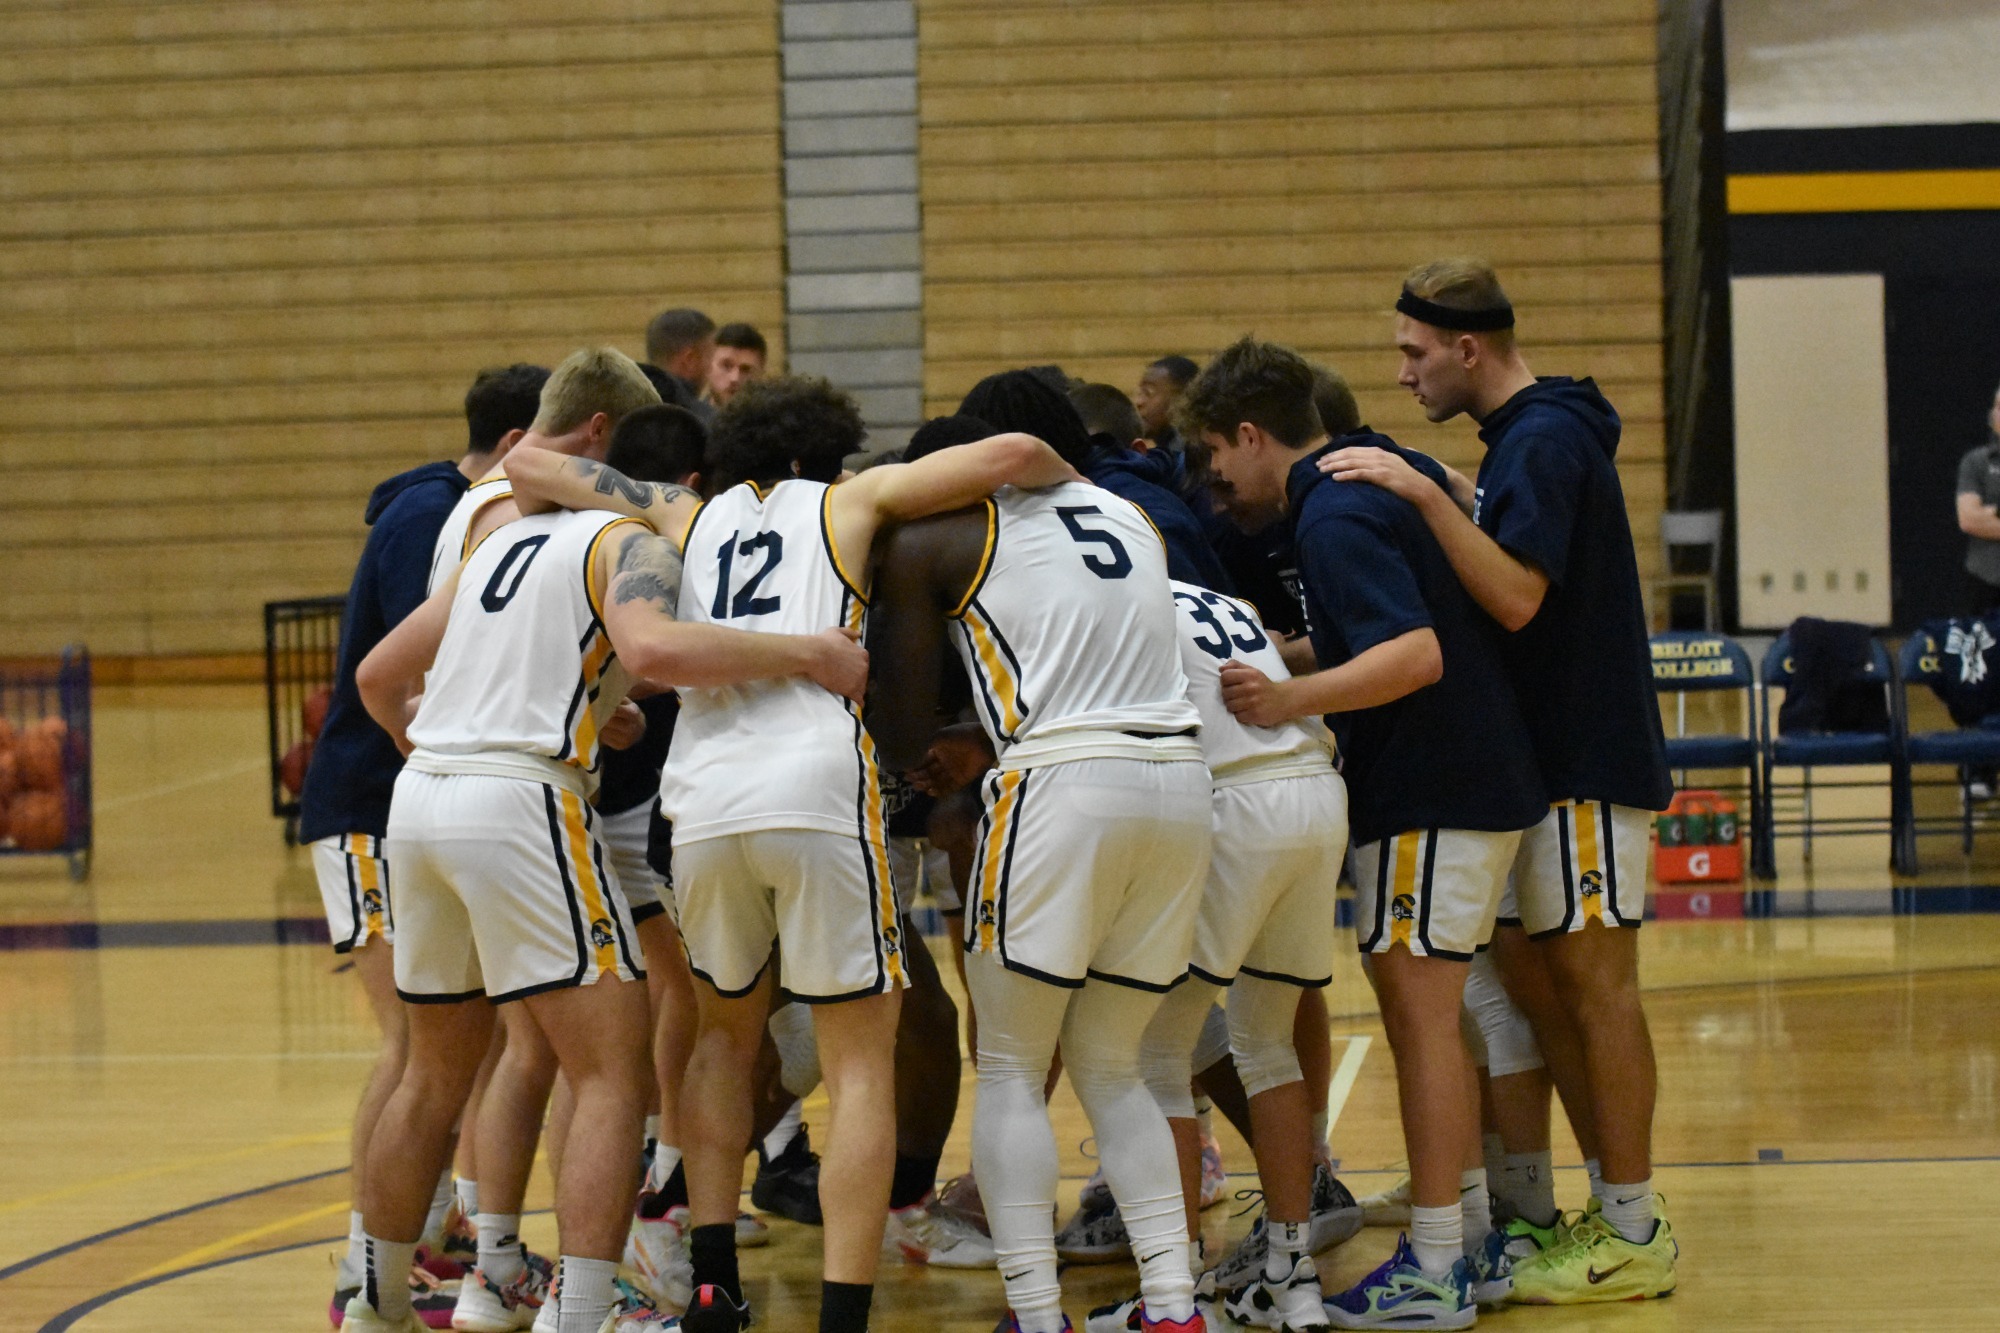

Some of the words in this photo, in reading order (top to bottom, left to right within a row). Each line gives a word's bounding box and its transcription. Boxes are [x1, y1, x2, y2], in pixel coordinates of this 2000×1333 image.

[480, 534, 551, 613] 0
[711, 530, 783, 619] 12
[1052, 505, 1133, 579] 5
[1172, 592, 1267, 659] 33
[1652, 658, 1734, 678] OLLEGE
[1688, 852, 1710, 877] G
